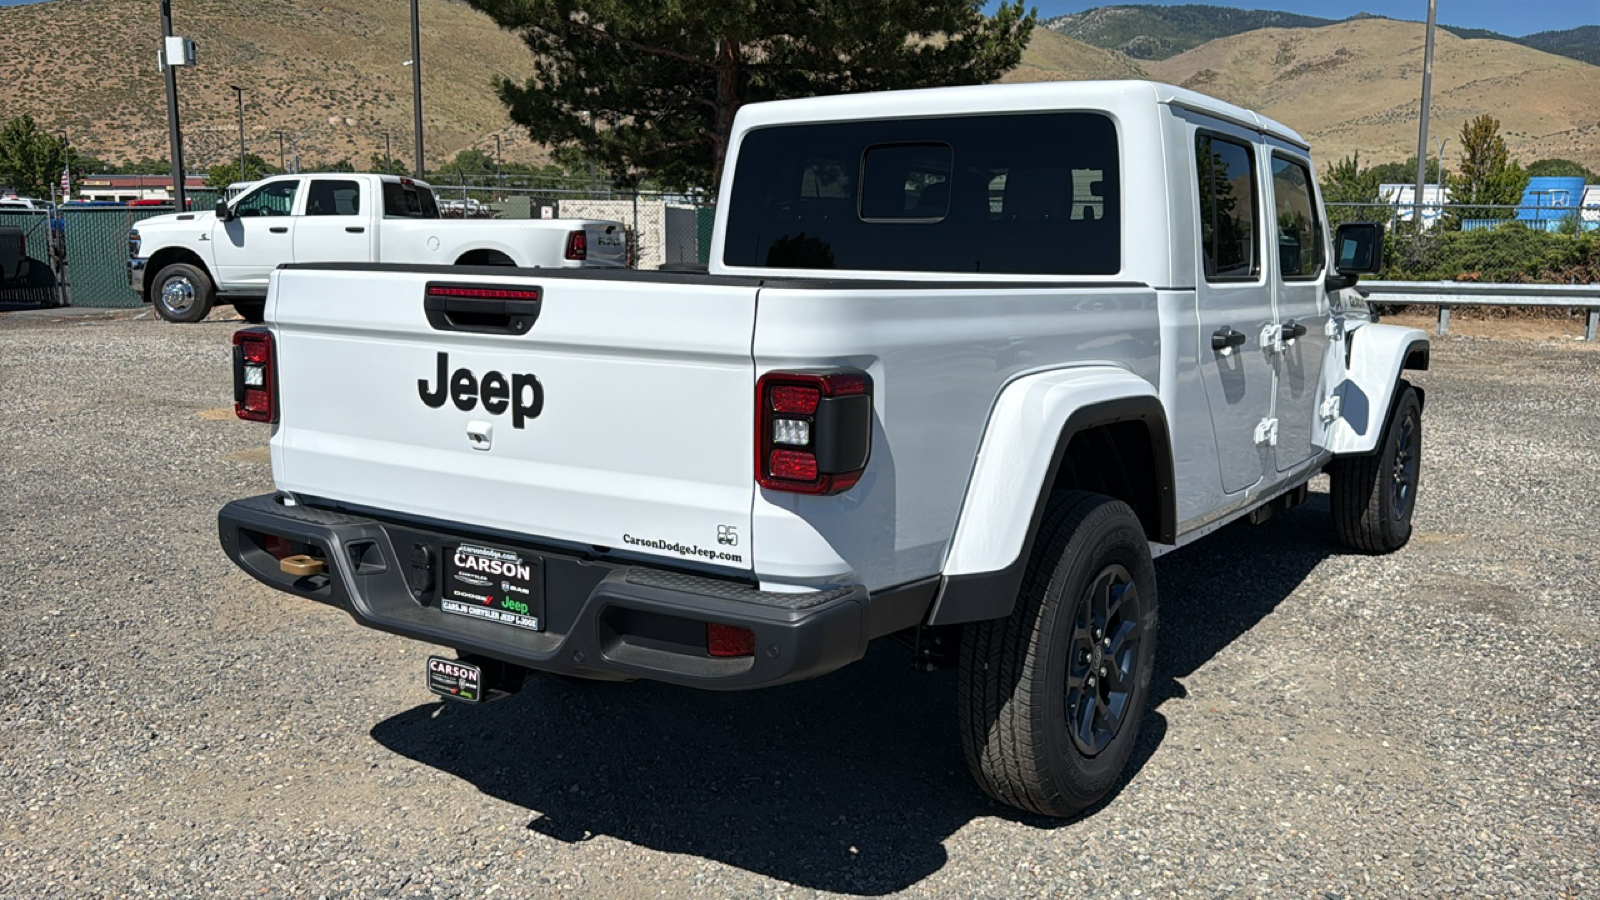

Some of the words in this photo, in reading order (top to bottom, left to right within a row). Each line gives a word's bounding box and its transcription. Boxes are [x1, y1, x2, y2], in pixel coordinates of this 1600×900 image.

[417, 351, 545, 430] Jeep
[622, 533, 743, 563] CarsonDodgeJeep.com
[453, 553, 531, 581] CARSON
[509, 585, 530, 595] RAM
[500, 595, 529, 615] Jeep
[430, 660, 477, 682] CARSON
